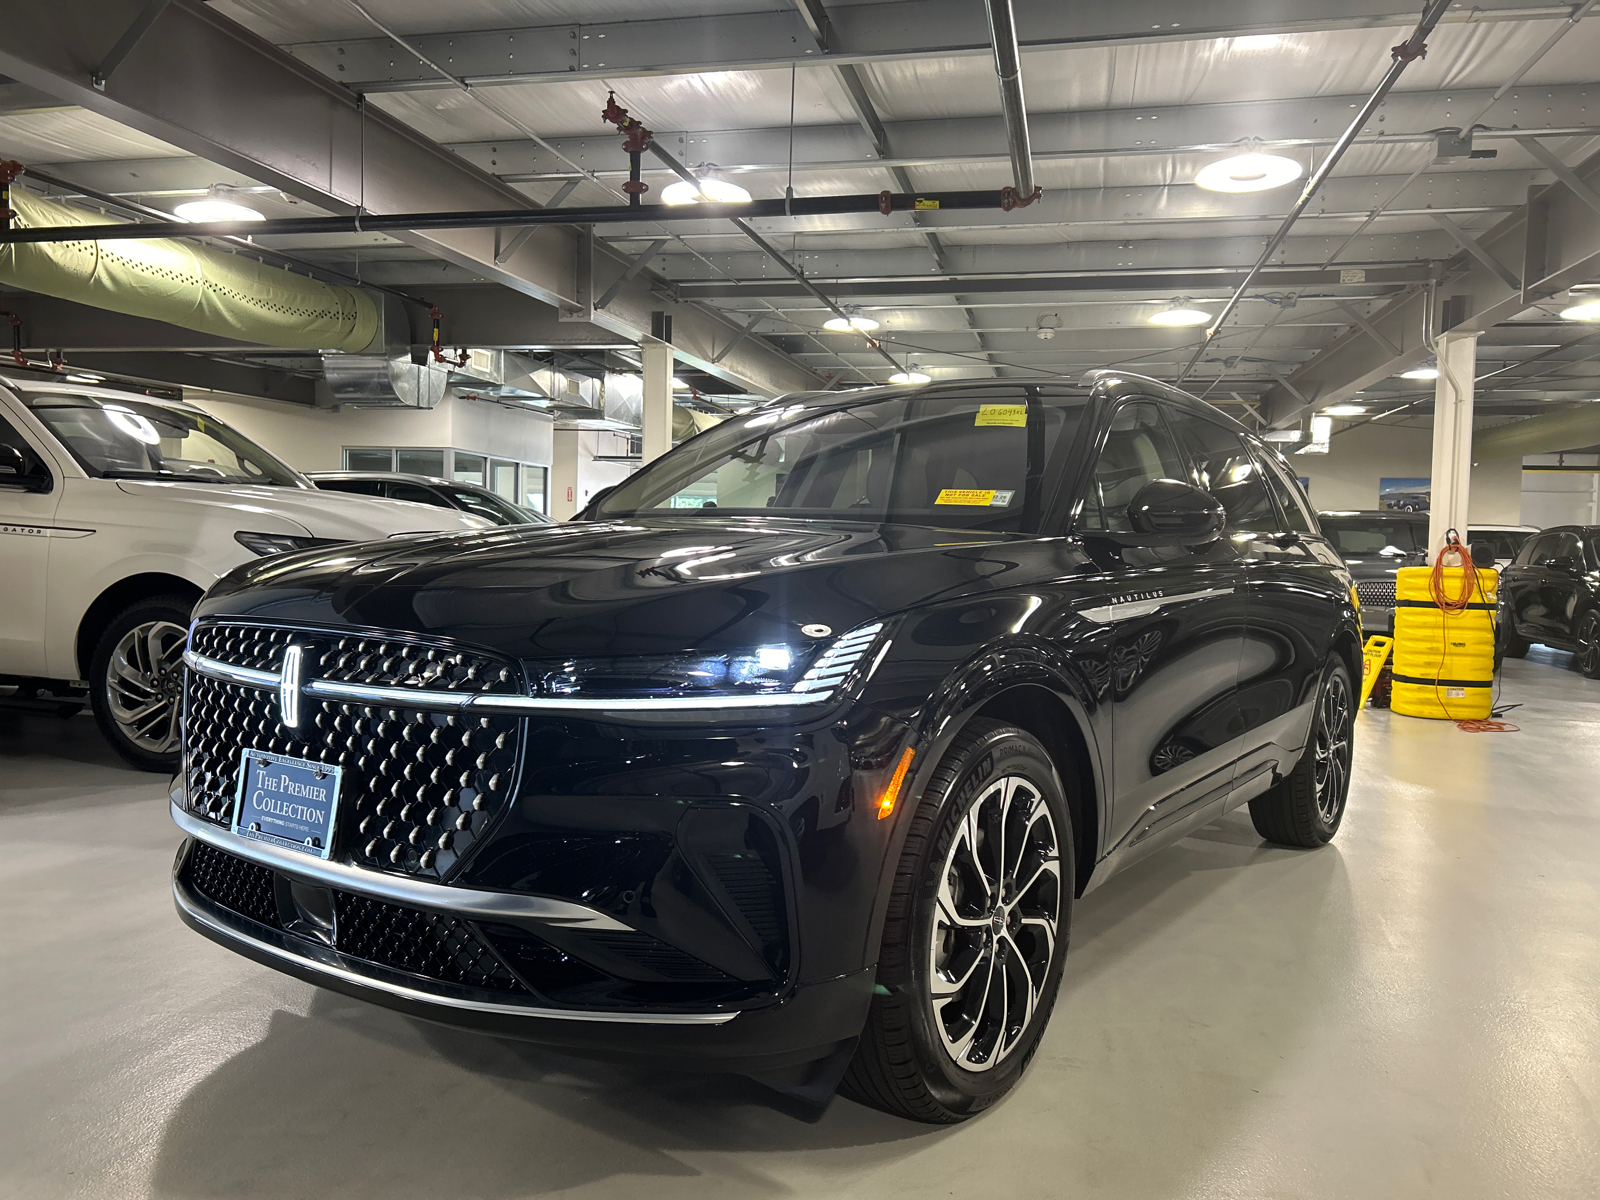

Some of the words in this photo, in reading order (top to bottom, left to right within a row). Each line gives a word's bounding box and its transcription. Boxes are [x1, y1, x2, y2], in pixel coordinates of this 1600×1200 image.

[1111, 590, 1164, 604] NAUTILUS
[256, 769, 278, 792] THE
[279, 774, 327, 802] PREMIER
[252, 790, 325, 825] COLLECTION
[261, 815, 285, 826] EVERYTHING
[937, 756, 993, 858] MICHELIN
